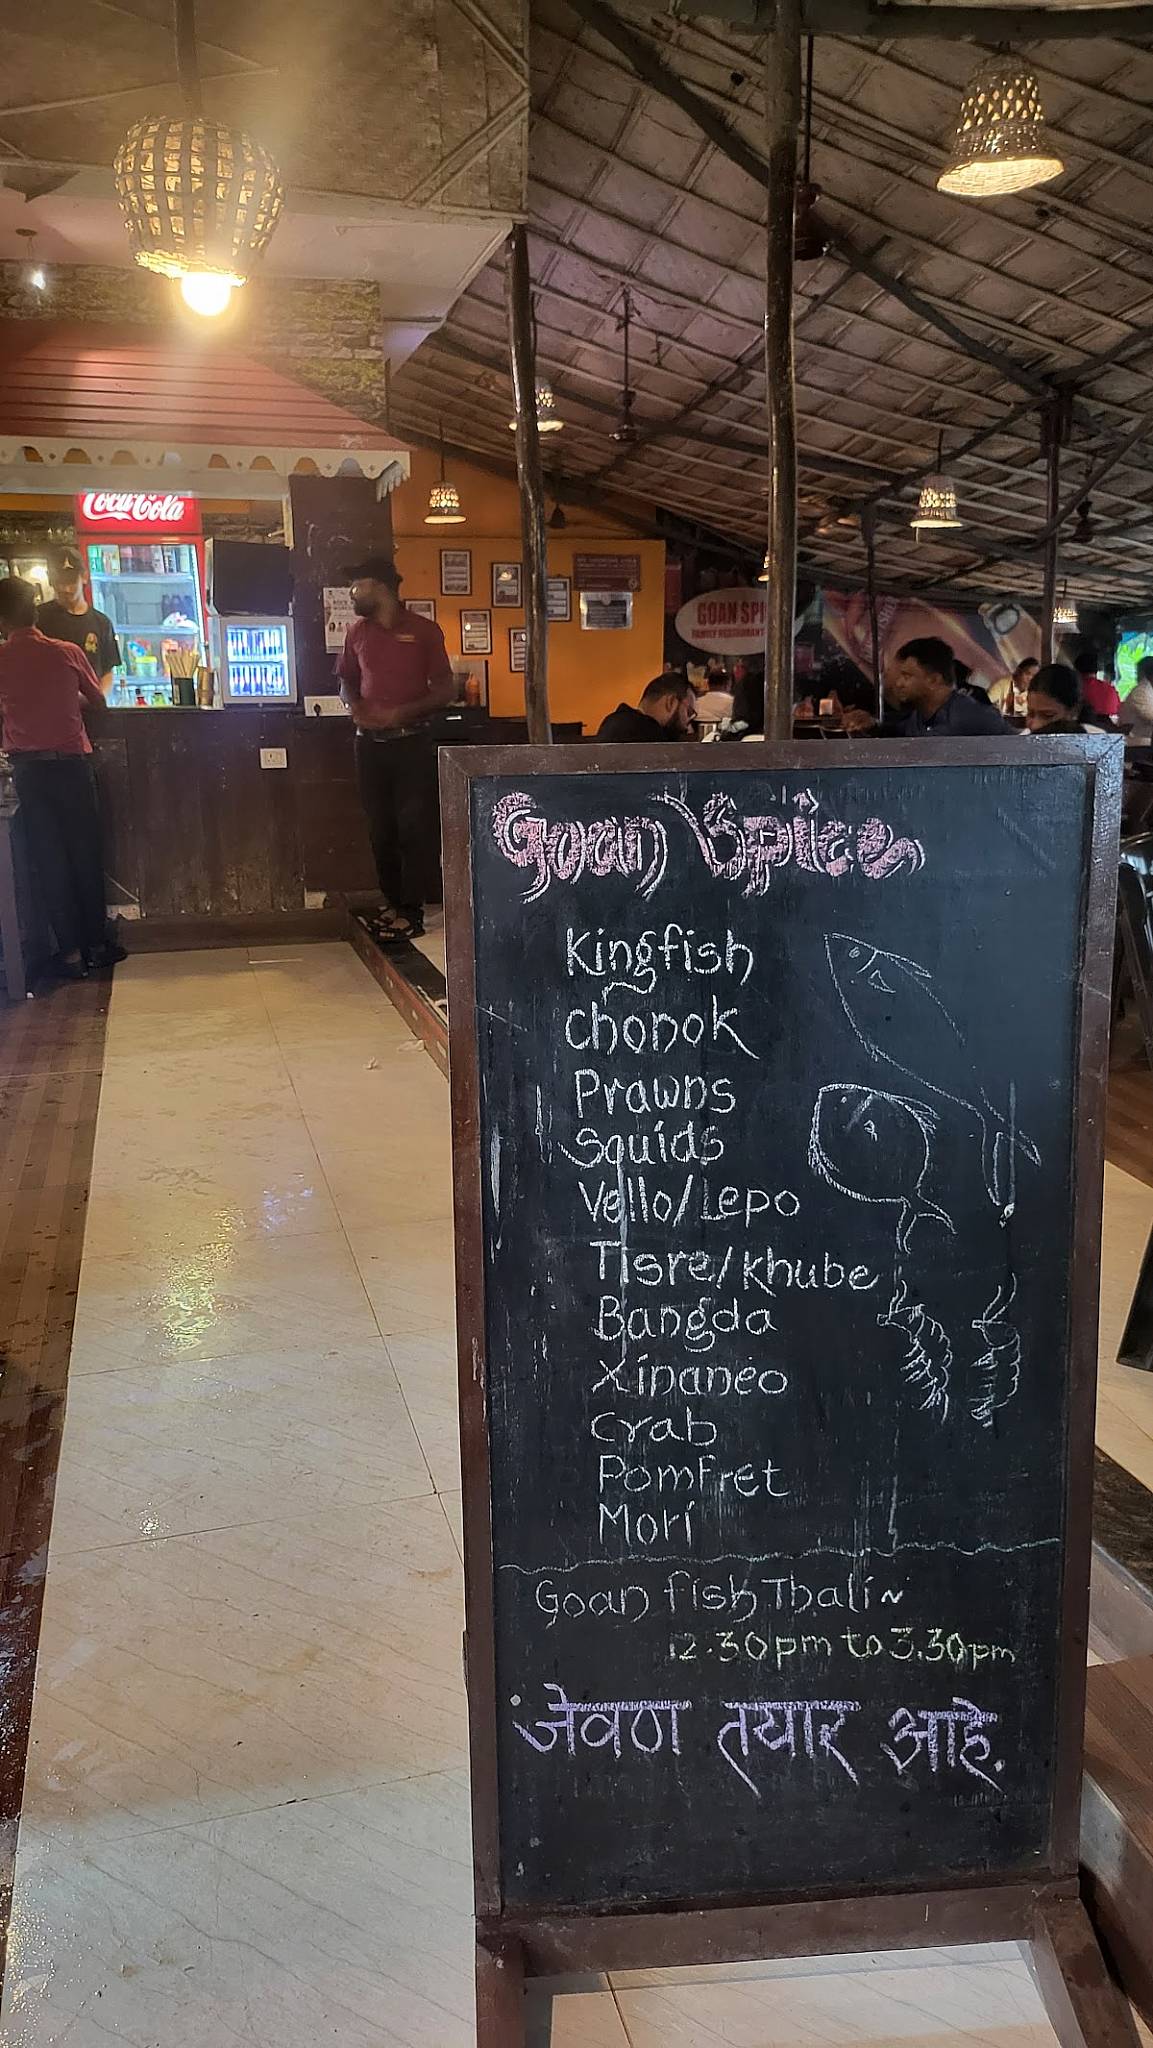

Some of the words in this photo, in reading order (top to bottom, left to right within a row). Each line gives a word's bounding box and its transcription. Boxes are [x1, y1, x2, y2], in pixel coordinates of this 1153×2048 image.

[697, 602, 737, 625] GOAN
[741, 601, 767, 624] SPI
[492, 791, 669, 904] Goan
[566, 922, 754, 1005] Kingfish
[574, 1068, 737, 1119] Prawns
[558, 1120, 726, 1169] Squids
[596, 1295, 778, 1352] Bangda
[591, 1406, 718, 1446] Crab
[599, 1454, 790, 1498] Pomfret
[599, 1500, 696, 1548] Mori
[535, 1579, 650, 1629] Goan
[663, 1570, 758, 1623] fish
[839, 1627, 883, 1658] to
[717, 1699, 862, 1796] तयार
